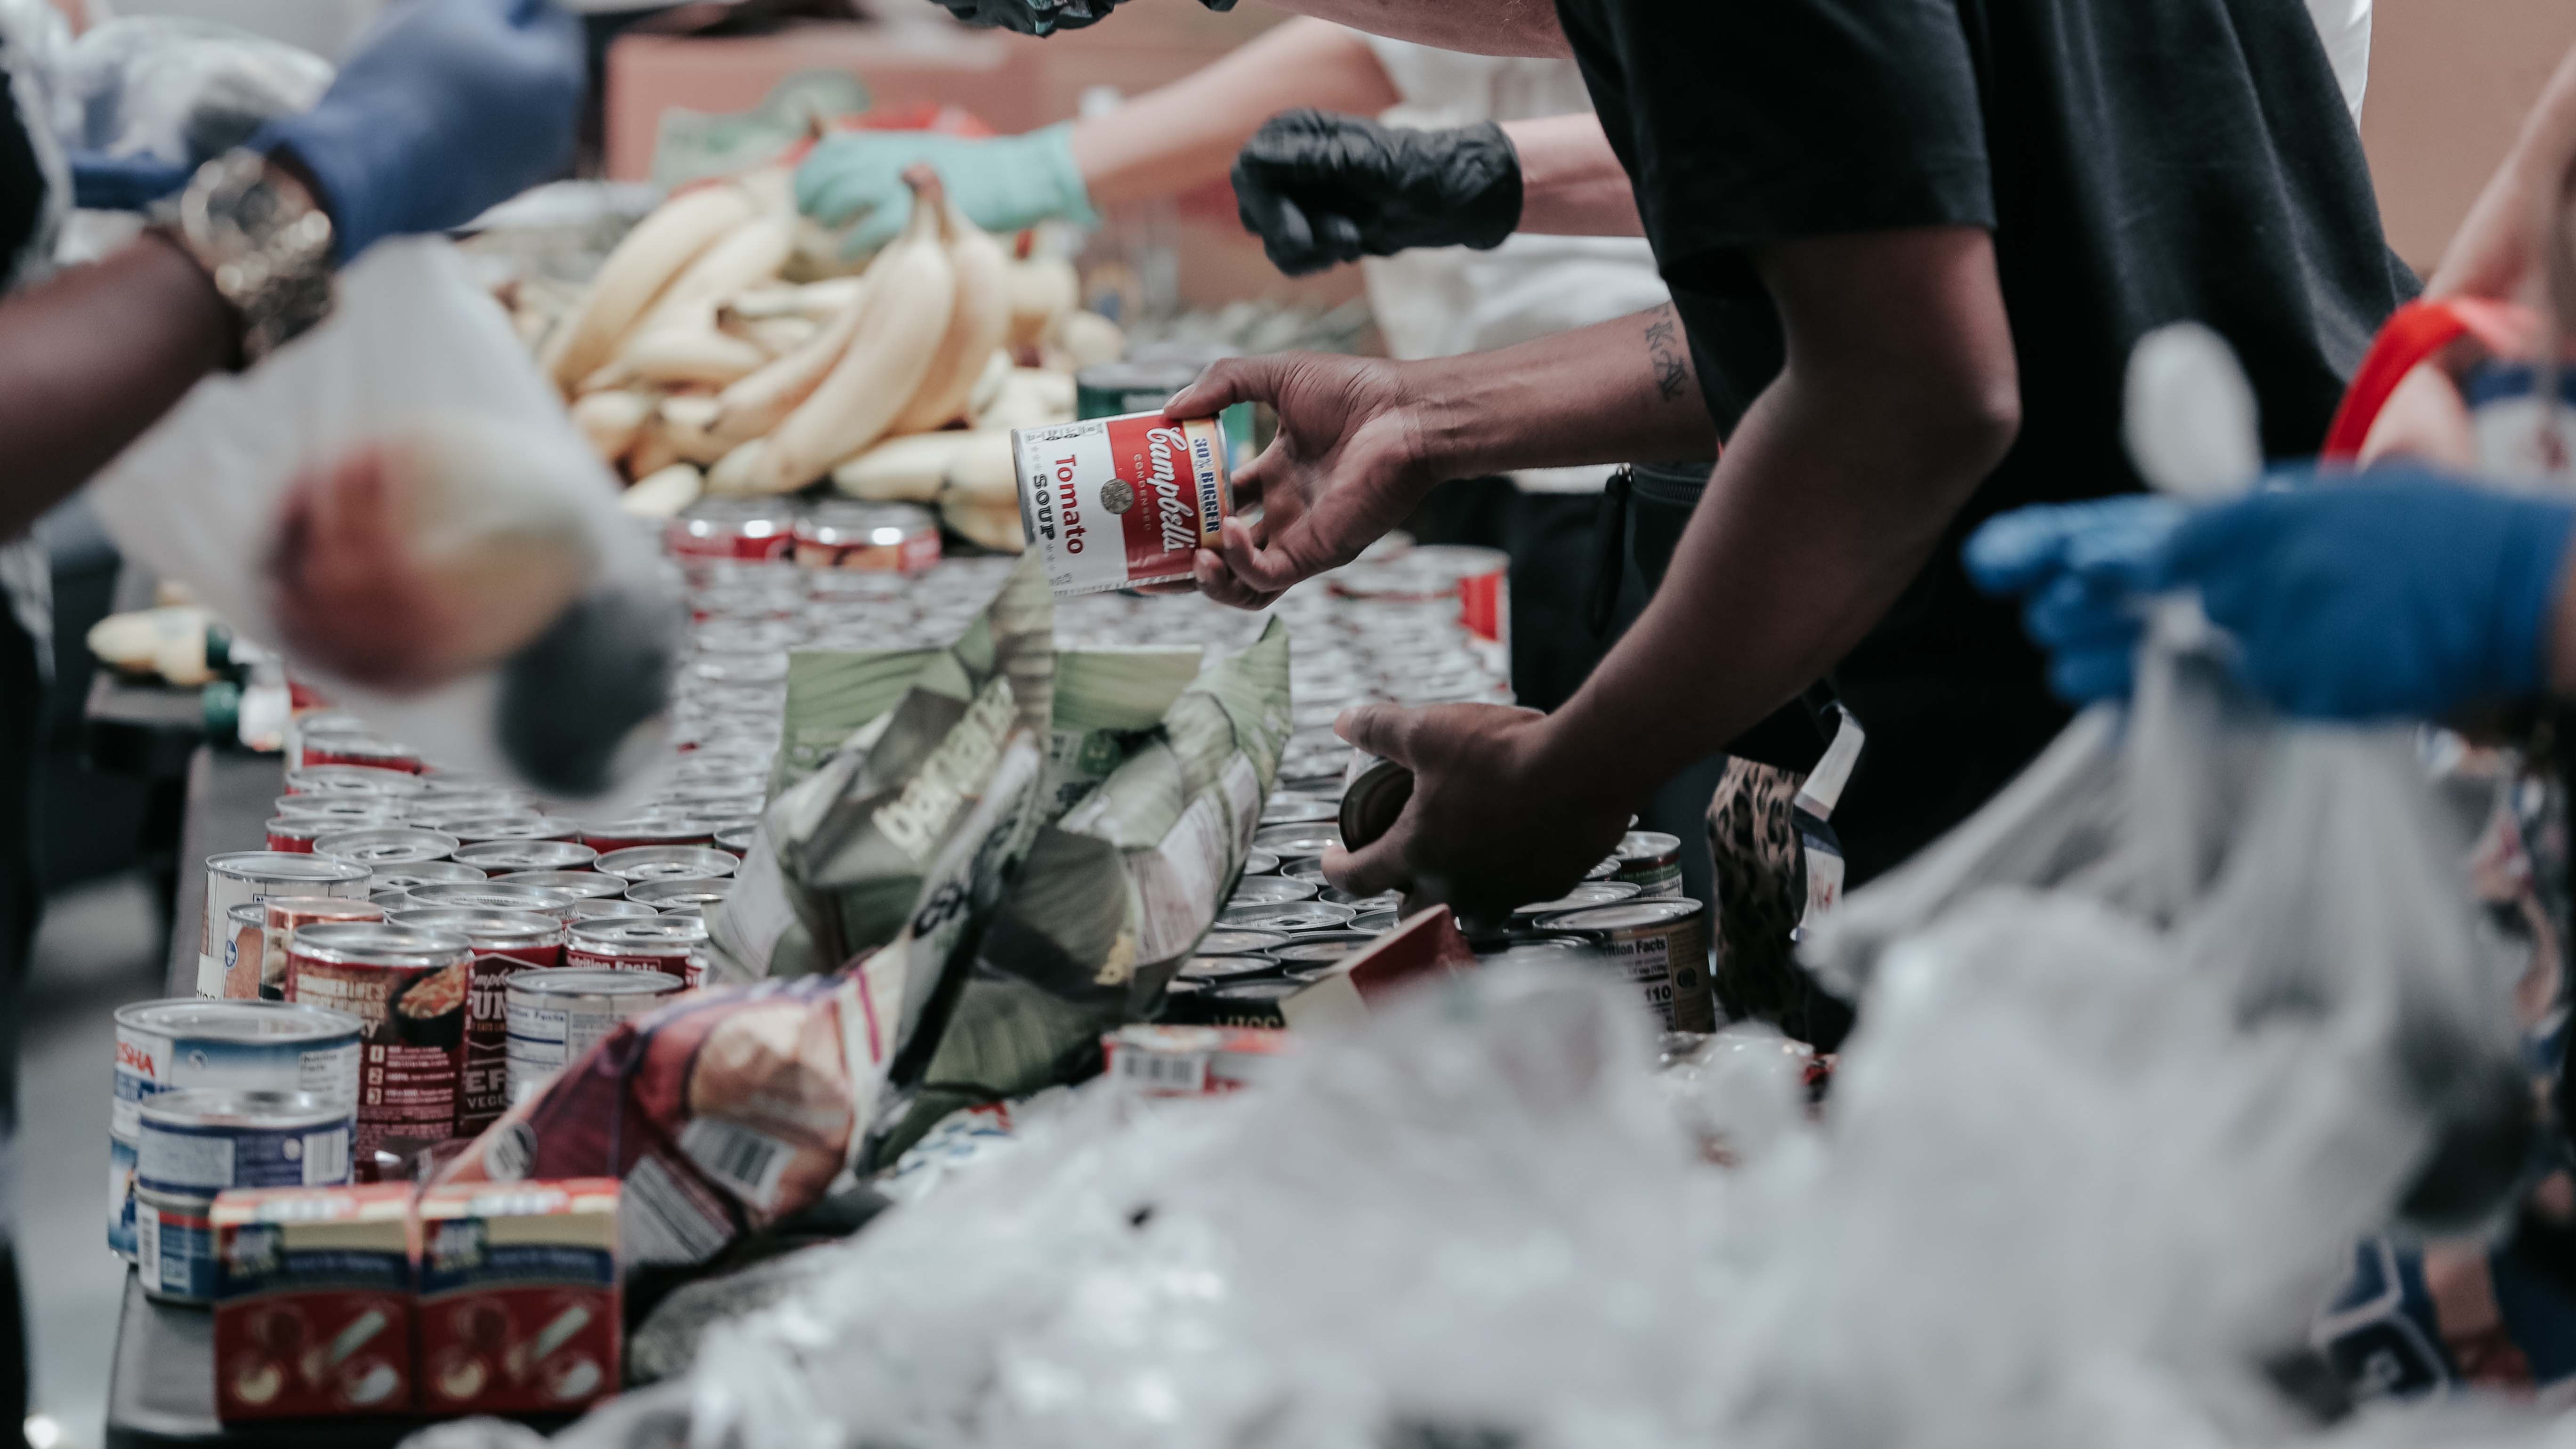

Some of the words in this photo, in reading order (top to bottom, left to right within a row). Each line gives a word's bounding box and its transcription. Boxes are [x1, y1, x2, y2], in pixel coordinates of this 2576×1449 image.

[1193, 437, 1215, 467] 30%
[1033, 474, 1056, 540] SOUP
[1055, 454, 1087, 554] Tomato
[1134, 453, 1152, 531] CONDENSED
[1146, 427, 1196, 553] Campbell's
[1200, 471, 1221, 533] BIGGER
[1635, 938, 1666, 954] Facts
[1646, 984, 1672, 1002] 110
